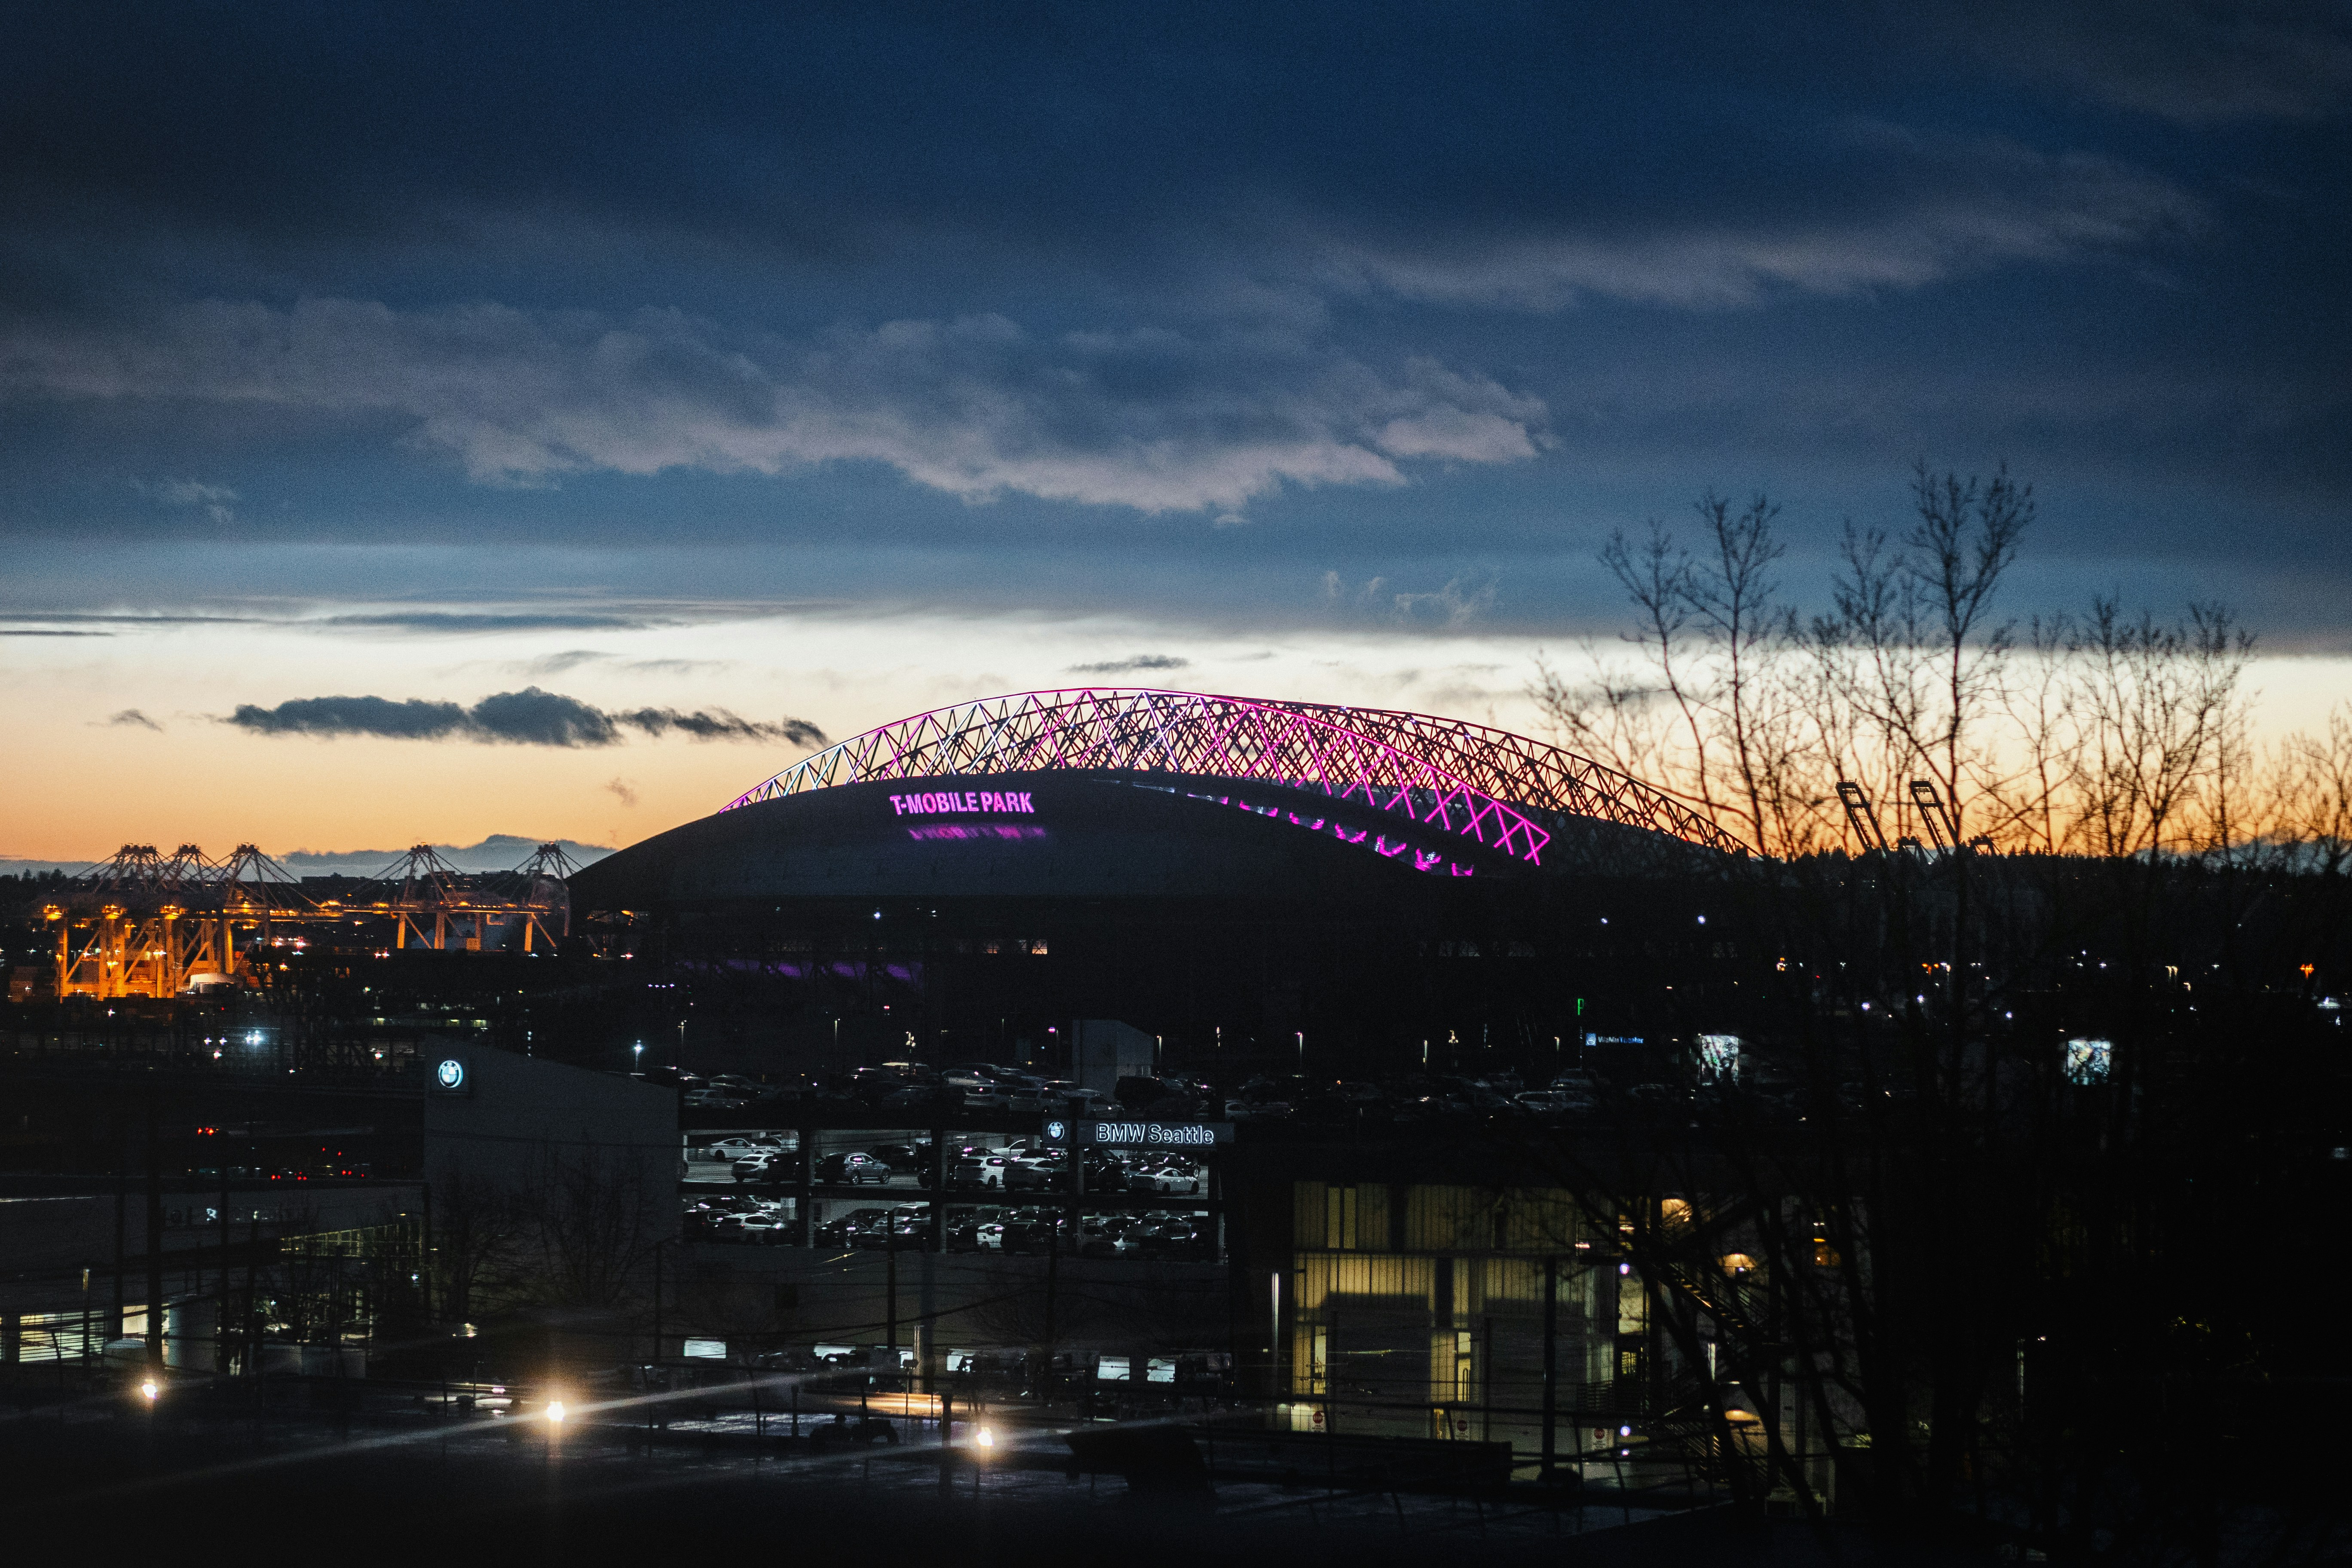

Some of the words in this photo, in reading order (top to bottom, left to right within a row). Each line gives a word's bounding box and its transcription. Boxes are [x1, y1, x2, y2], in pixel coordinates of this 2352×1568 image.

[890, 792, 979, 815] T-MOBILE
[980, 792, 1035, 813] PARK
[1096, 1123, 1145, 1142] BMW
[1148, 1124, 1214, 1145] Seattle
